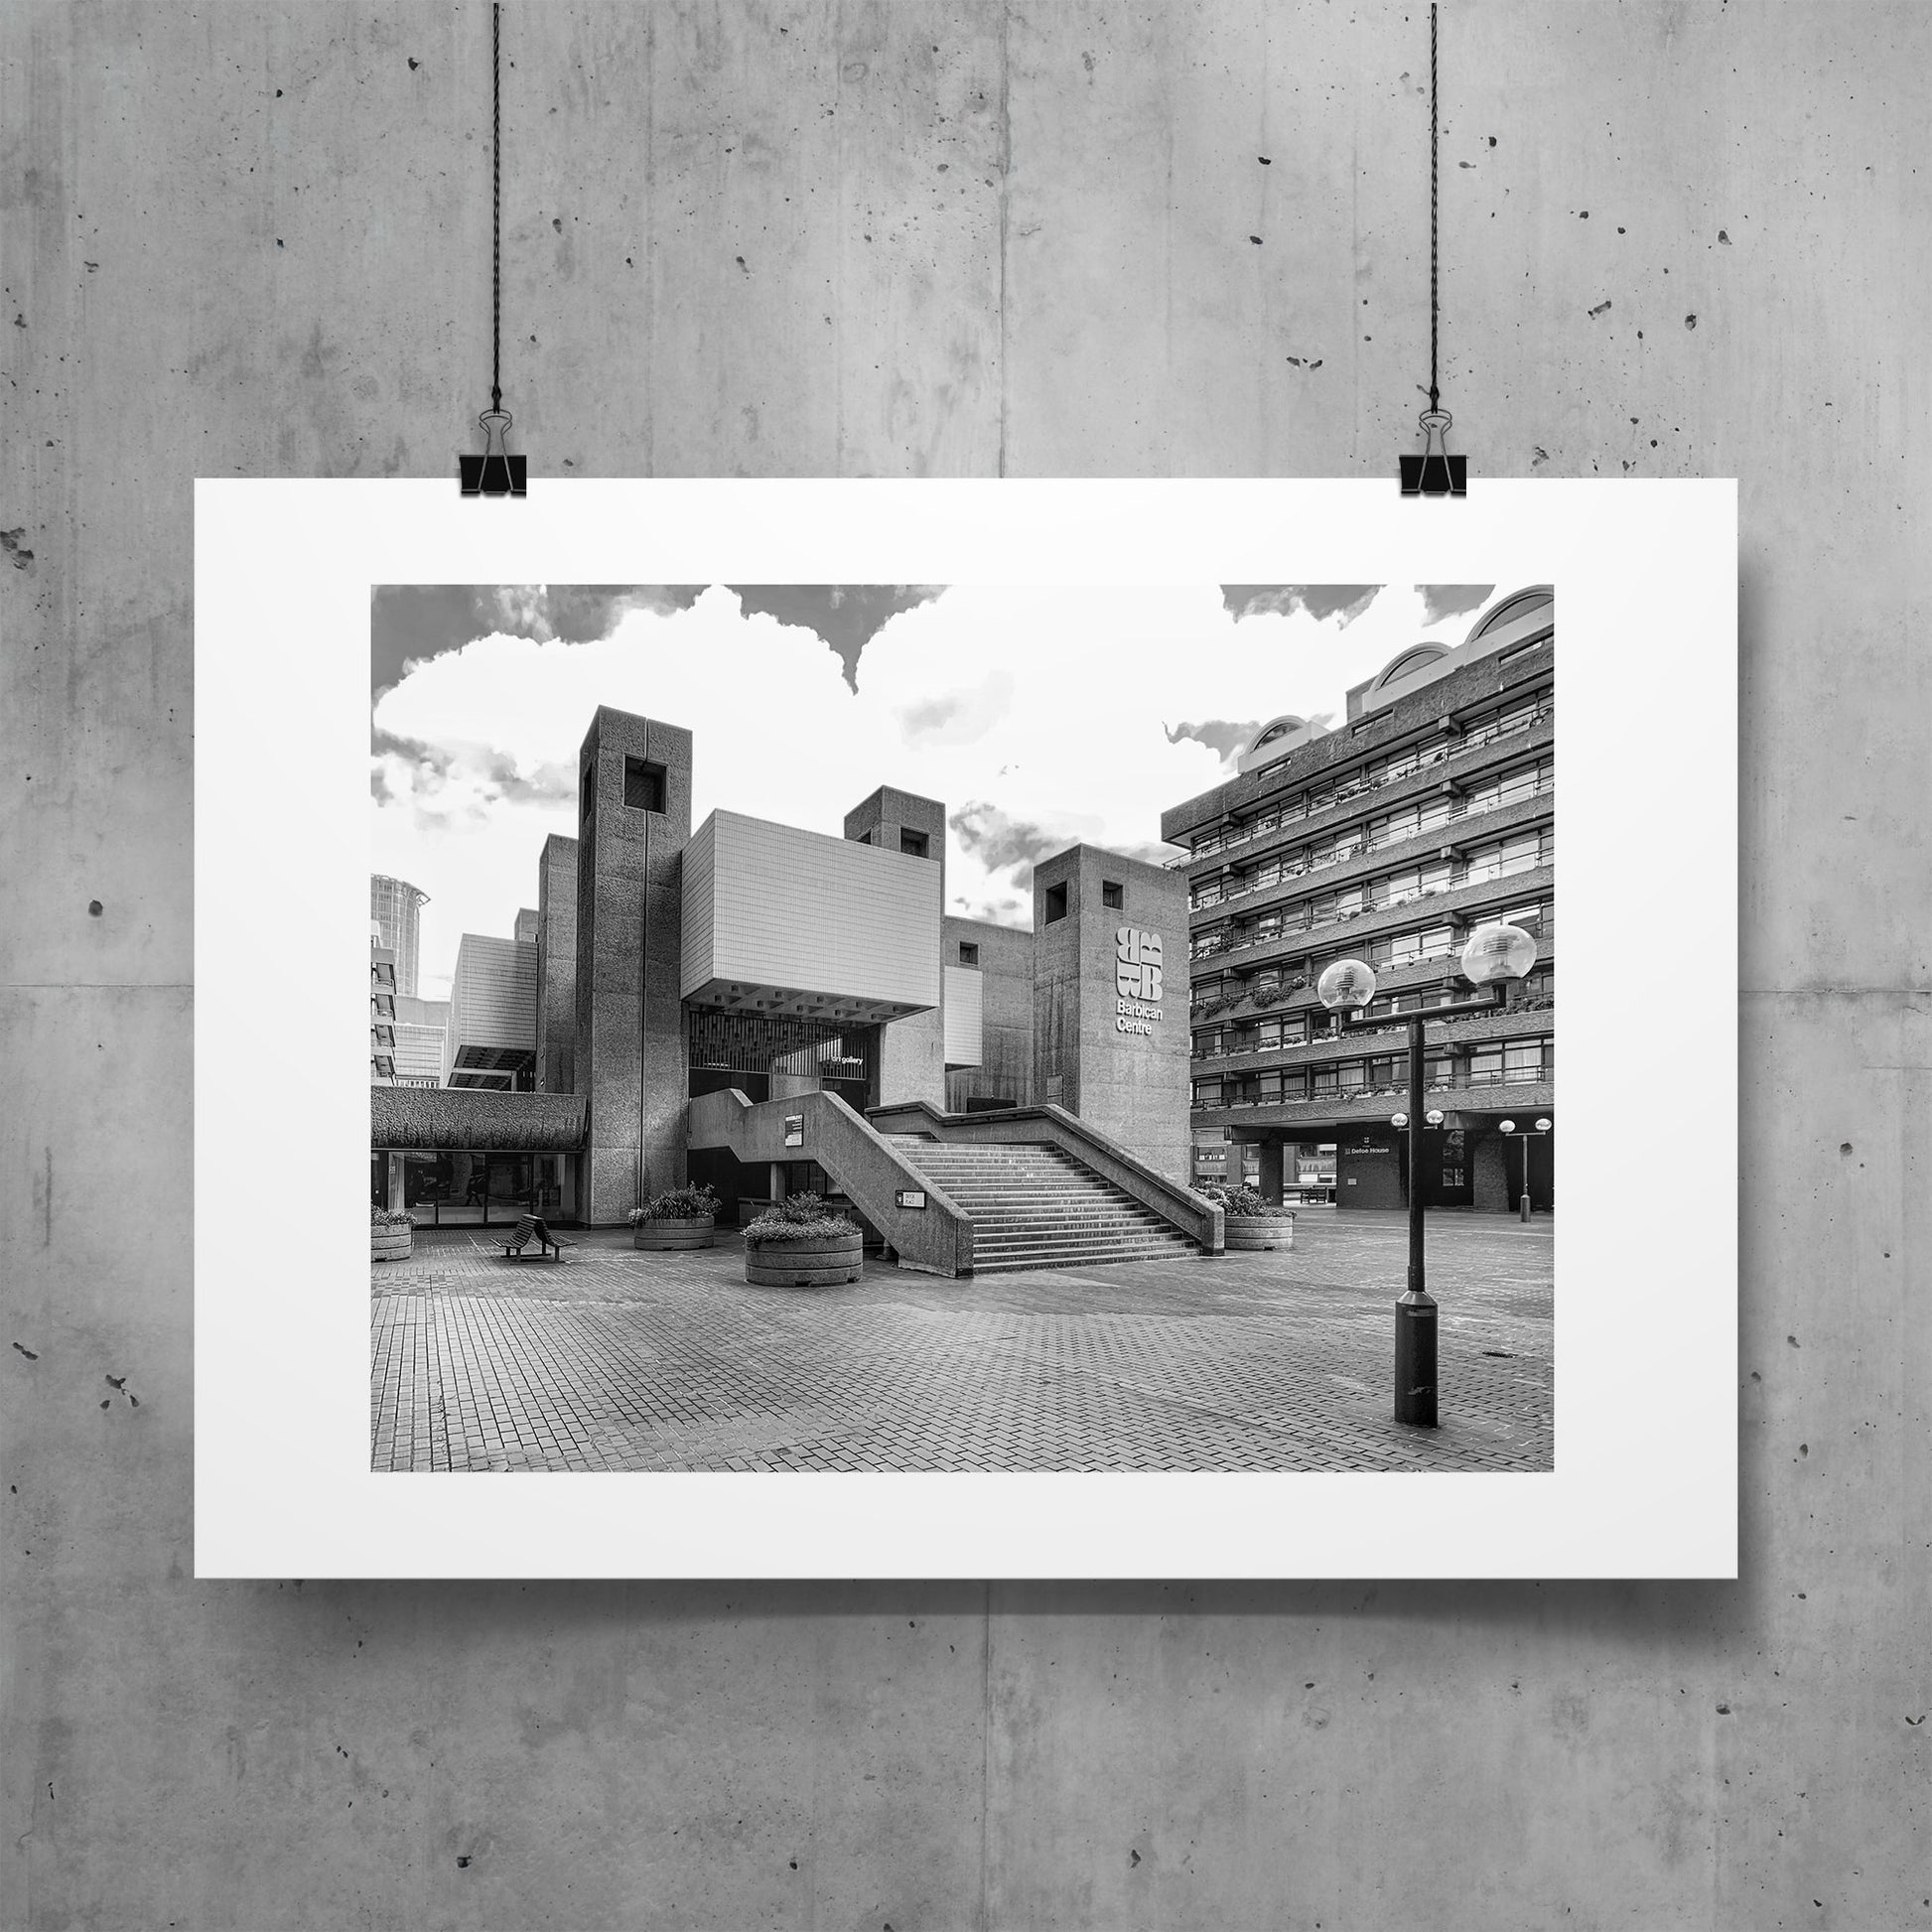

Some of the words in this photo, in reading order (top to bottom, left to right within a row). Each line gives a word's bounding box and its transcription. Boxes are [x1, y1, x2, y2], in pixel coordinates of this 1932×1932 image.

[1116, 999, 1163, 1021] Barbican
[1116, 1018, 1152, 1035] Centre
[841, 1055, 864, 1065] gallery
